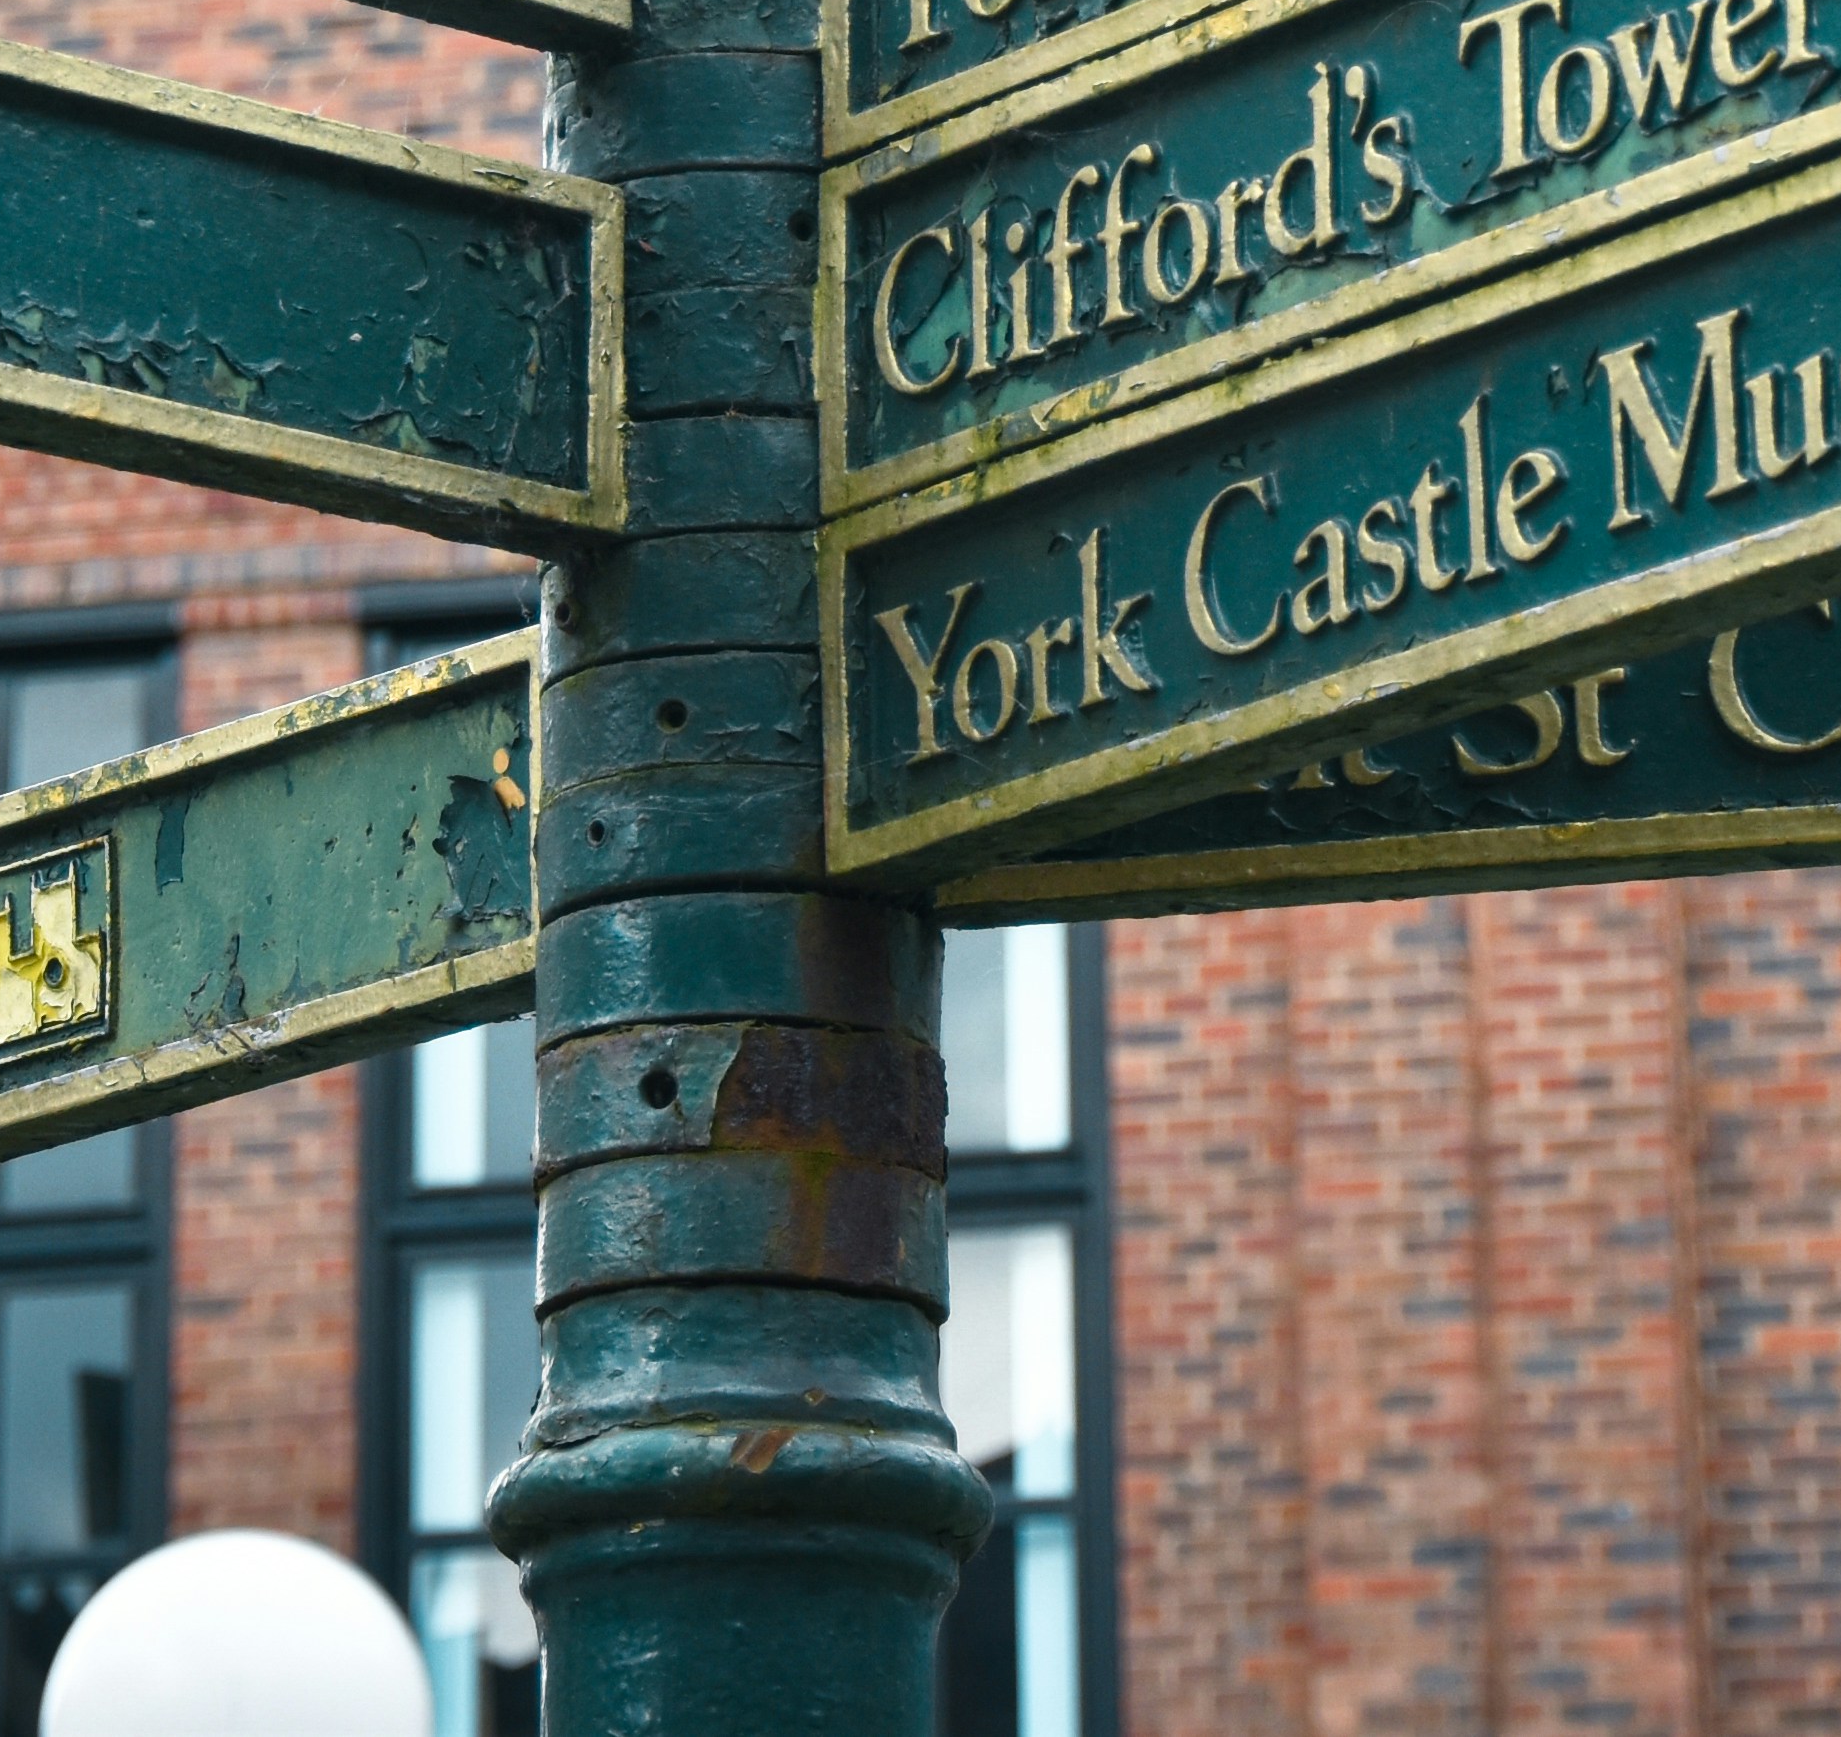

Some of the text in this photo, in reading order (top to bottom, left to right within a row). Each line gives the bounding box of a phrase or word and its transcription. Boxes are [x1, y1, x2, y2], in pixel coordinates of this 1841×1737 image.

[872, 61, 1408, 396] Clifford's
[874, 527, 1154, 766] York
[1184, 392, 1562, 655] Castle
